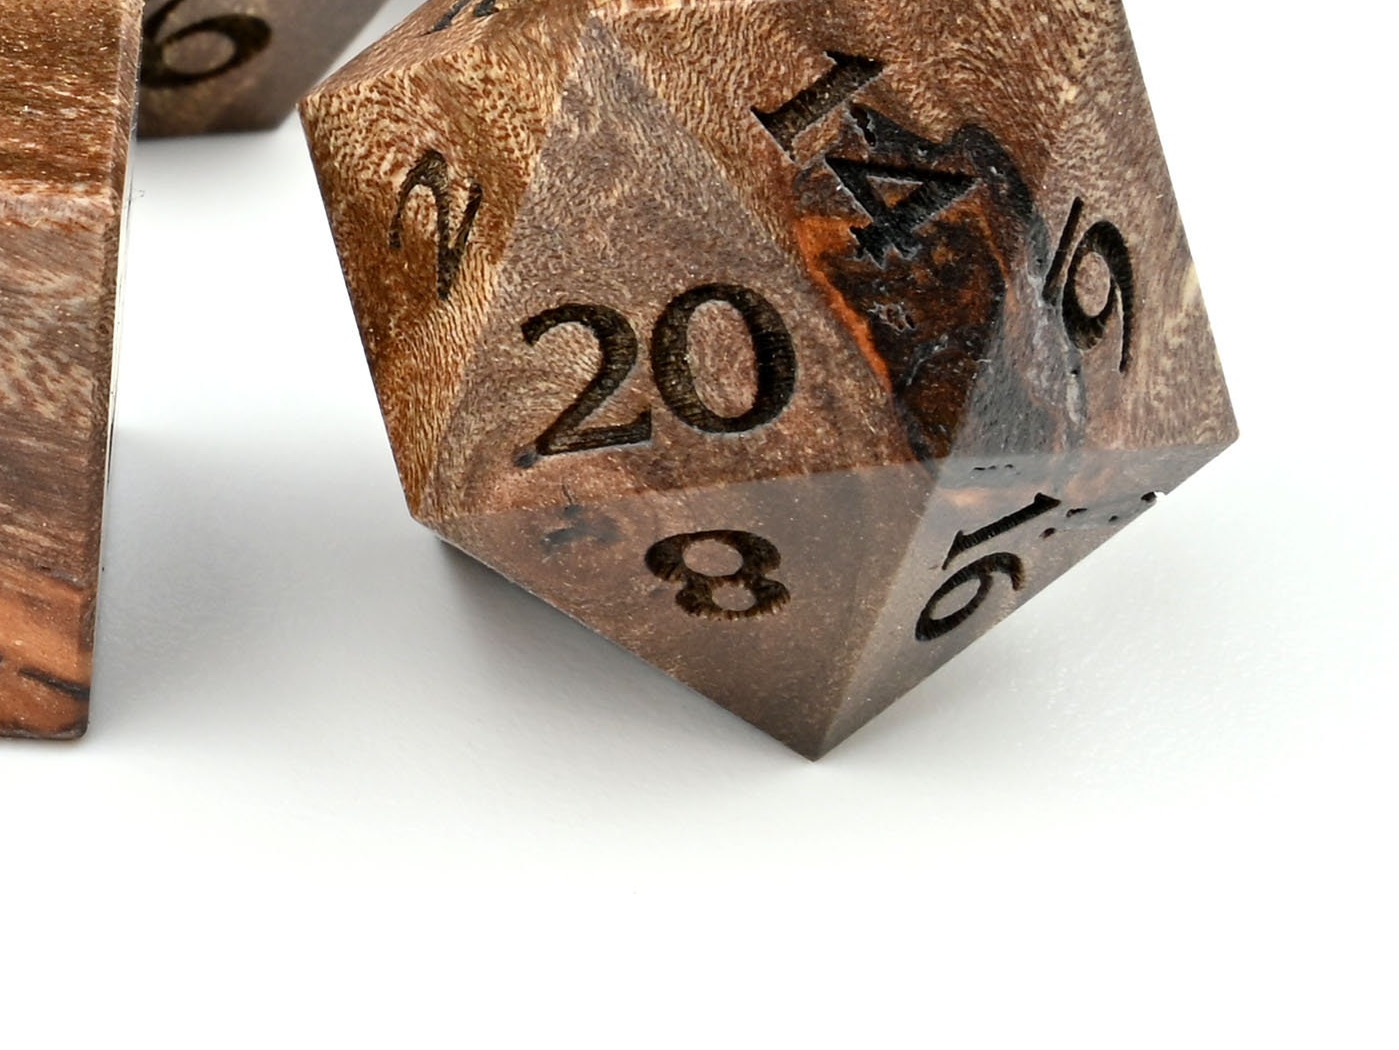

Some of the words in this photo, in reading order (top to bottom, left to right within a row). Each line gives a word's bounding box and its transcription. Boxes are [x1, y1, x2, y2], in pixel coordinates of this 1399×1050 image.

[388, 149, 484, 300] 2
[750, 50, 982, 268] 14
[516, 282, 798, 465] 20
[644, 529, 792, 623] 8
[915, 492, 1060, 642] 16
